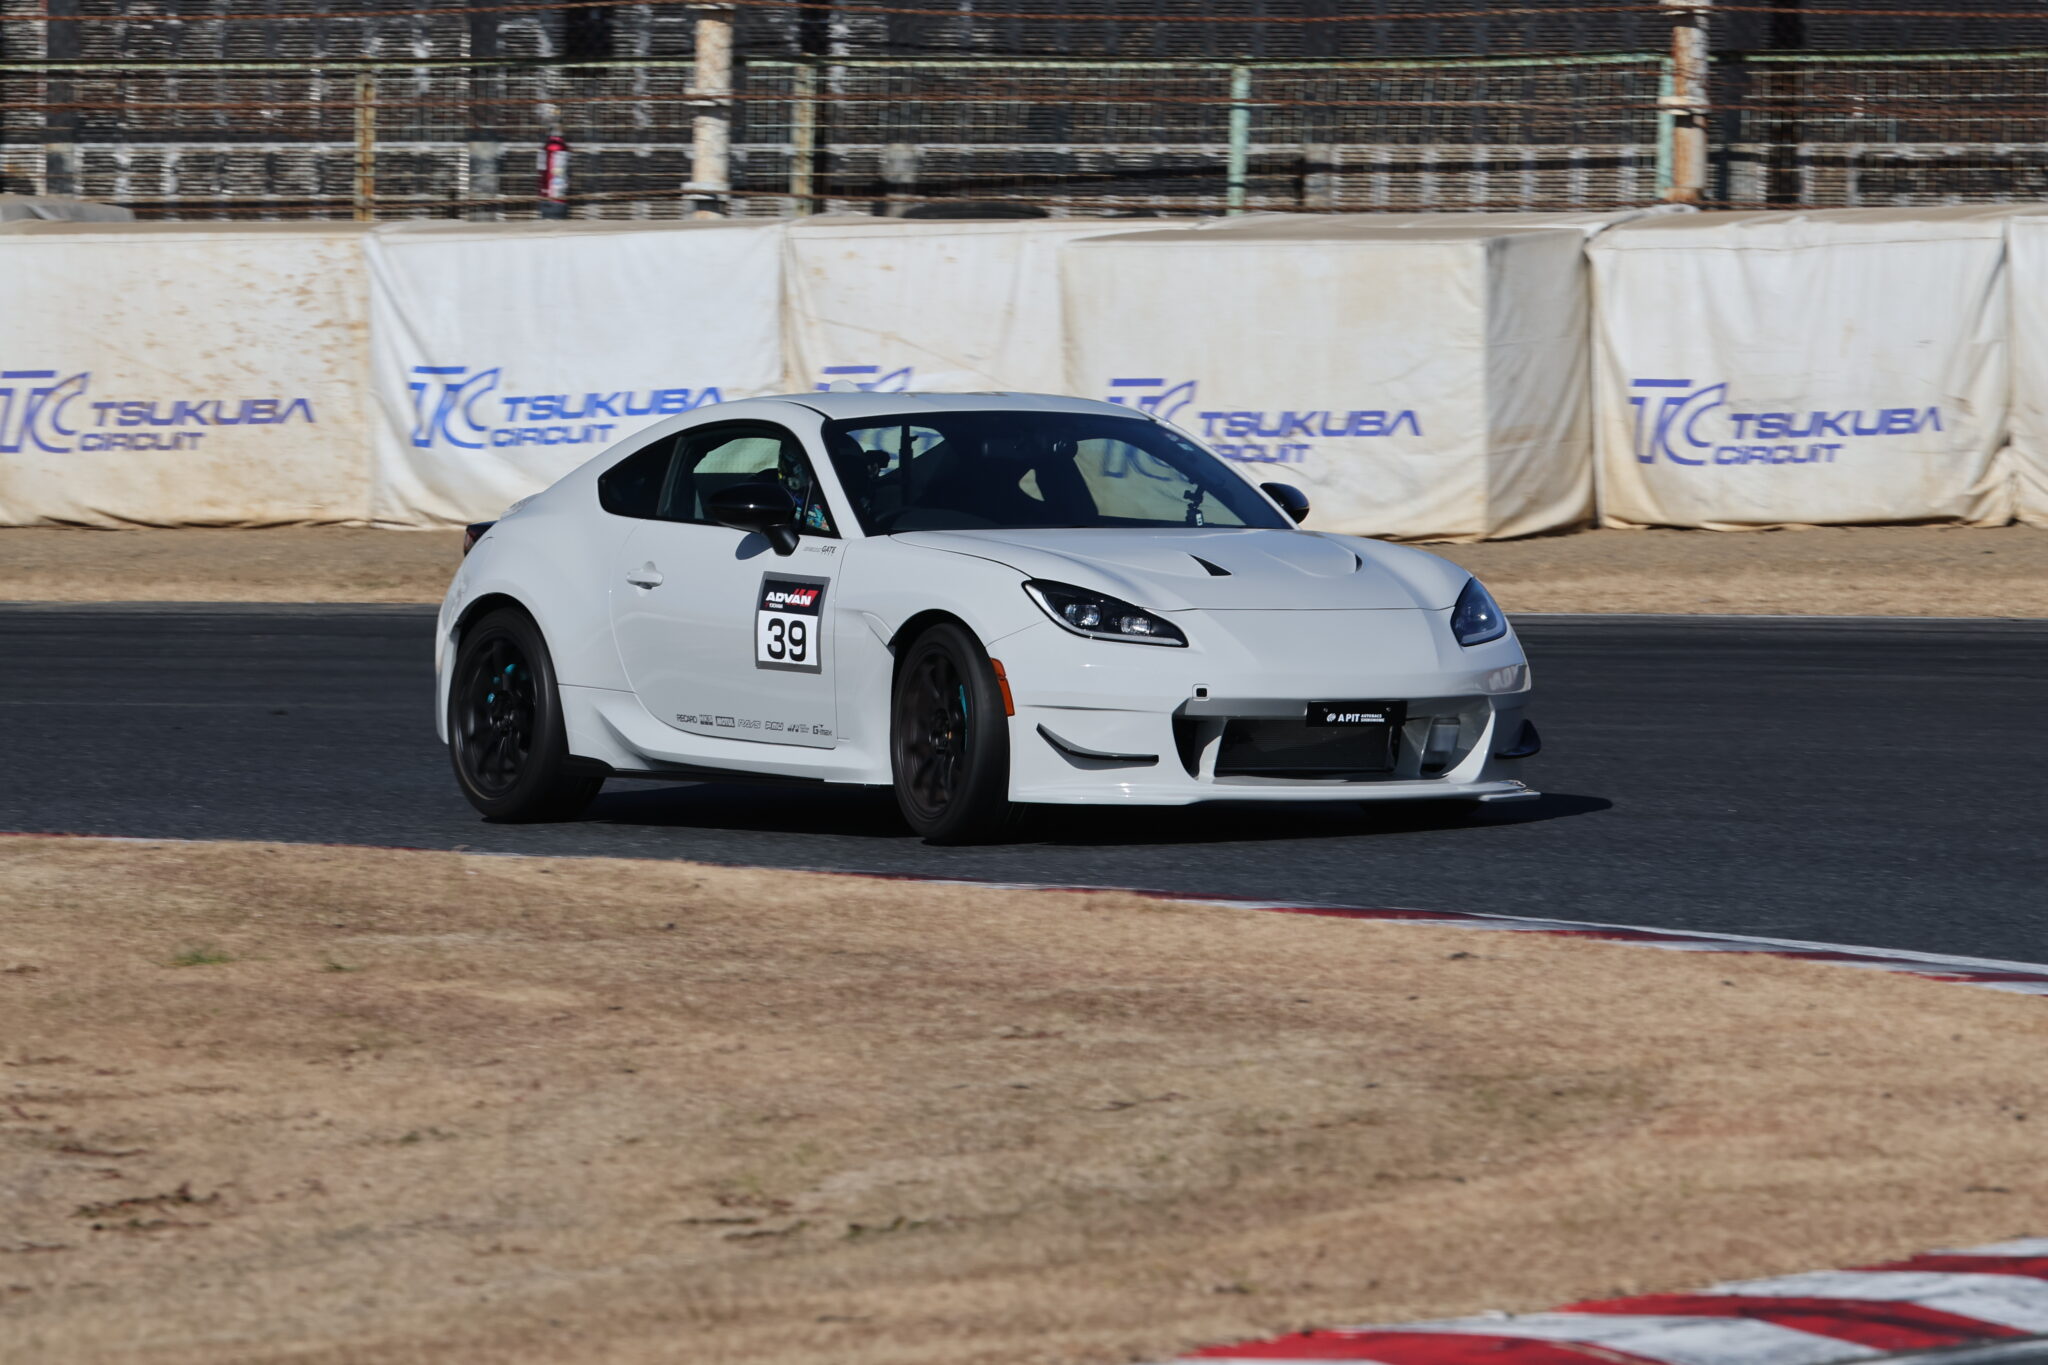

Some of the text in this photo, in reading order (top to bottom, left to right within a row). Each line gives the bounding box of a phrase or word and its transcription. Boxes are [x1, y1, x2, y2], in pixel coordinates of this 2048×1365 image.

[91, 400, 314, 427] TSUKUBA
[409, 365, 502, 449] TC
[500, 387, 722, 422] TSUKUBA
[1199, 411, 1421, 437] TSUKUBA
[1629, 378, 1729, 466] TC
[1728, 407, 1944, 440] TSUKUBA
[80, 431, 205, 452] CIRCUIT
[490, 424, 616, 448] CIRCUIT
[1713, 443, 1845, 466] CIRCUIT
[765, 591, 812, 606] ADVAN
[767, 617, 807, 663] 39
